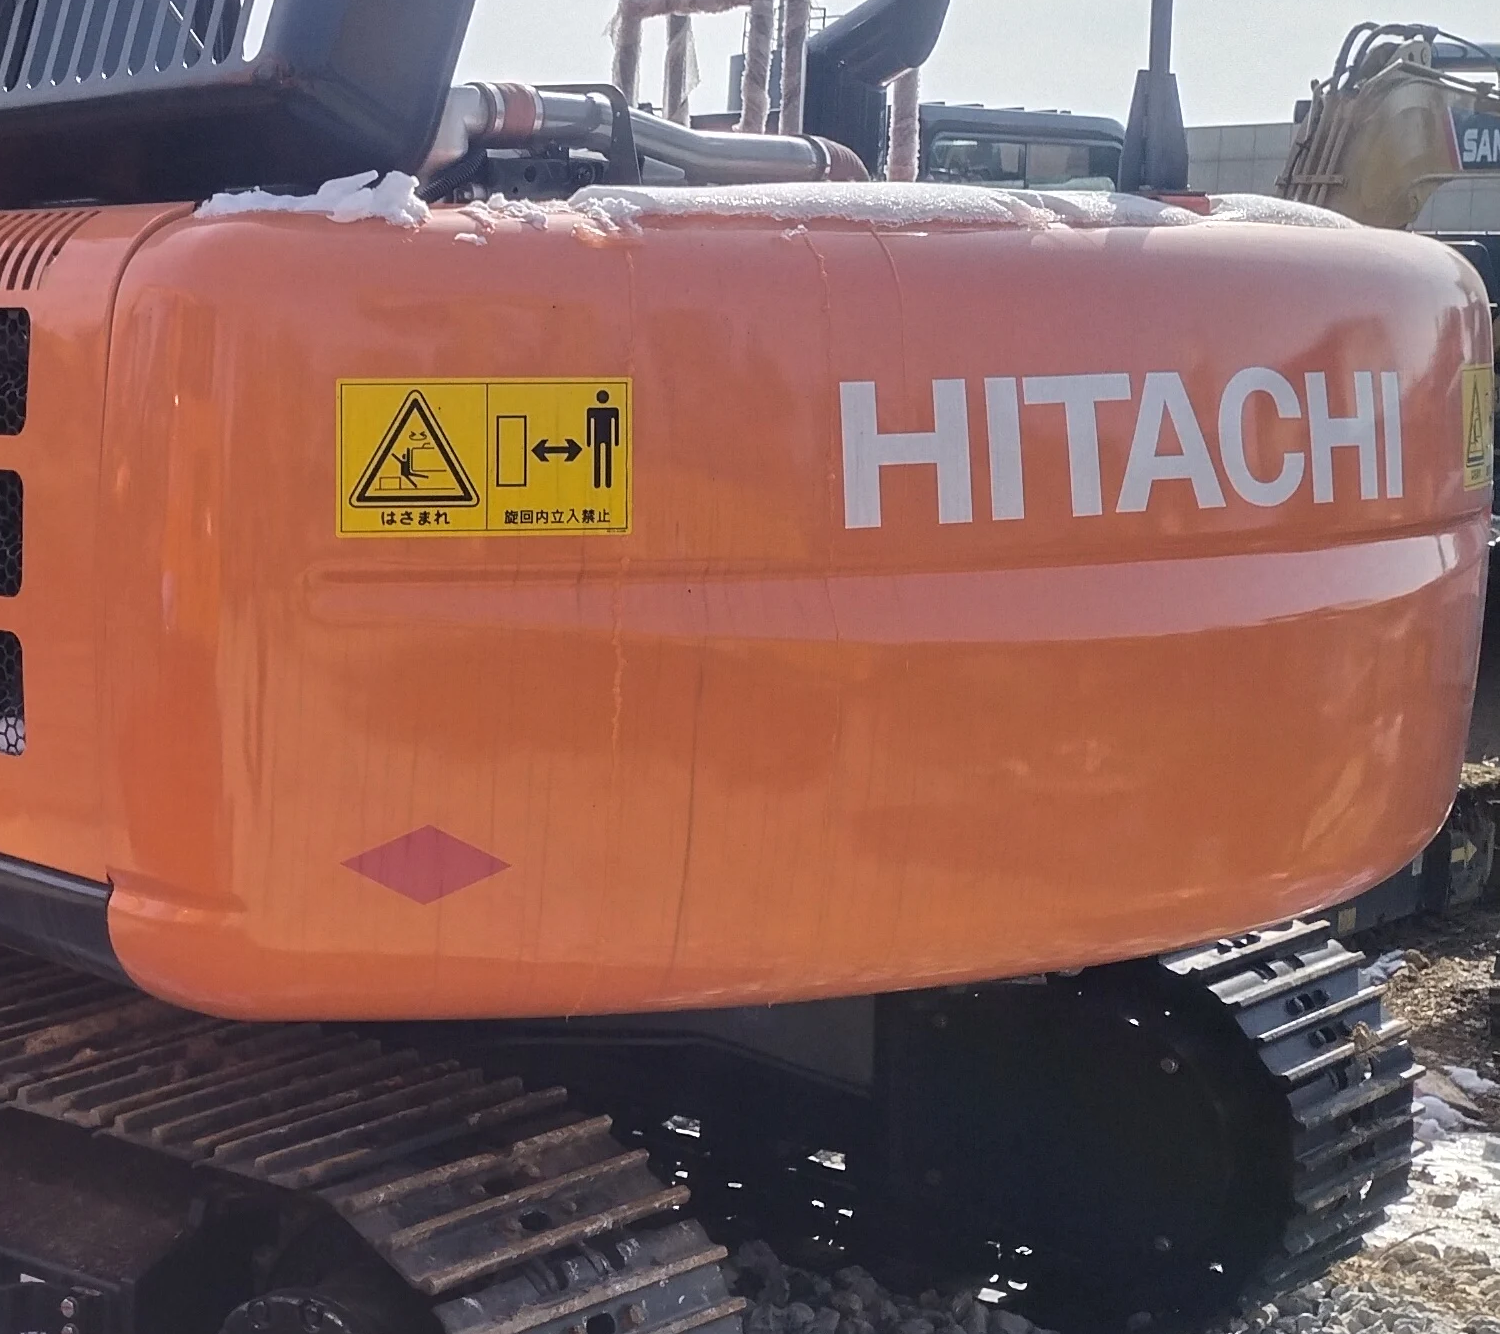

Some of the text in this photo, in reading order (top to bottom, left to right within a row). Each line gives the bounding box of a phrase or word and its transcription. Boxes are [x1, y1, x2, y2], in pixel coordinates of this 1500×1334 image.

[840, 366, 1404, 529] HITACHI
[381, 510, 450, 526] はさまれ
[504, 509, 610, 524] 旋回内立入禁止
